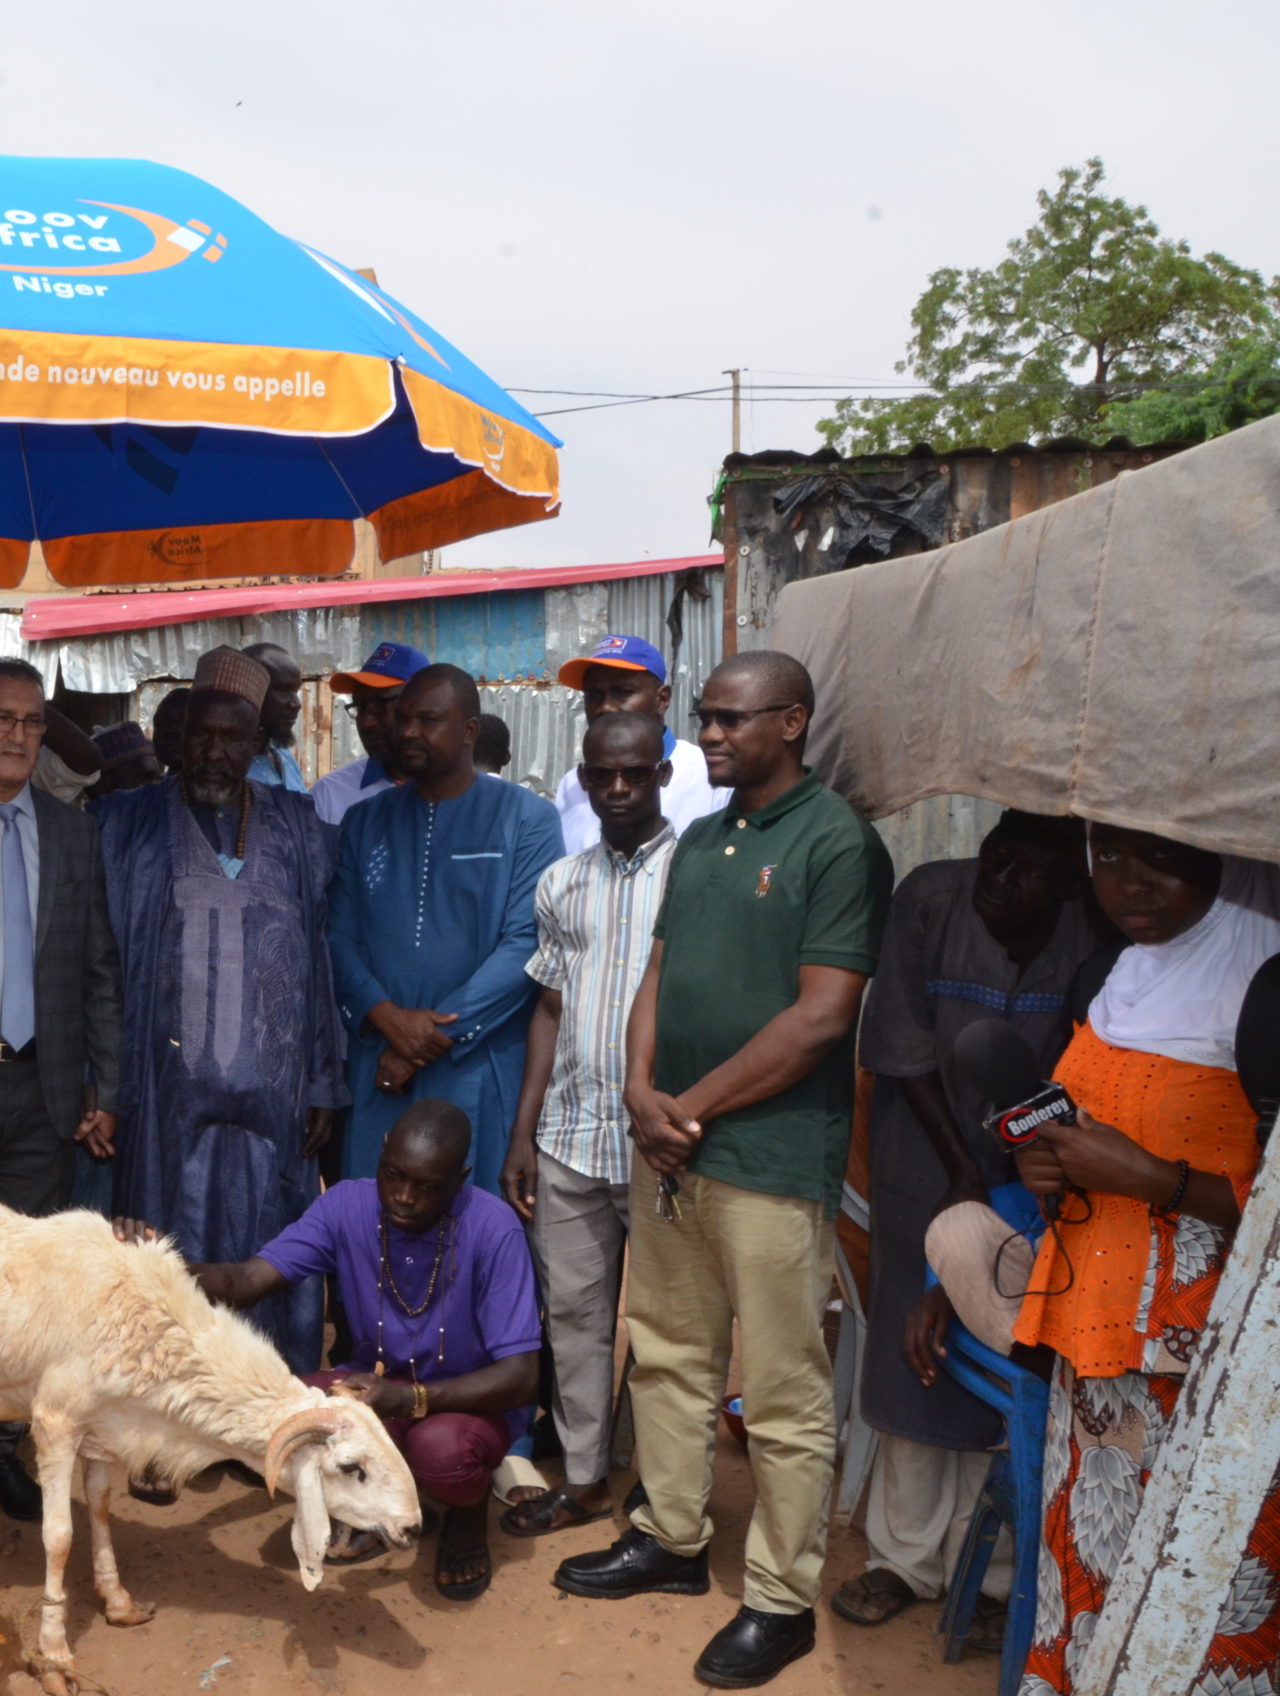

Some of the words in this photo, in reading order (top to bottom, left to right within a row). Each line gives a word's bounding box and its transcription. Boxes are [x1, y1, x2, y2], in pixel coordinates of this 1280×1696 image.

[12, 275, 109, 299] Niger
[47, 365, 159, 387] nouveau
[165, 370, 227, 392] vous
[232, 371, 326, 402] appelle
[1007, 1098, 1069, 1136] Bonferey
